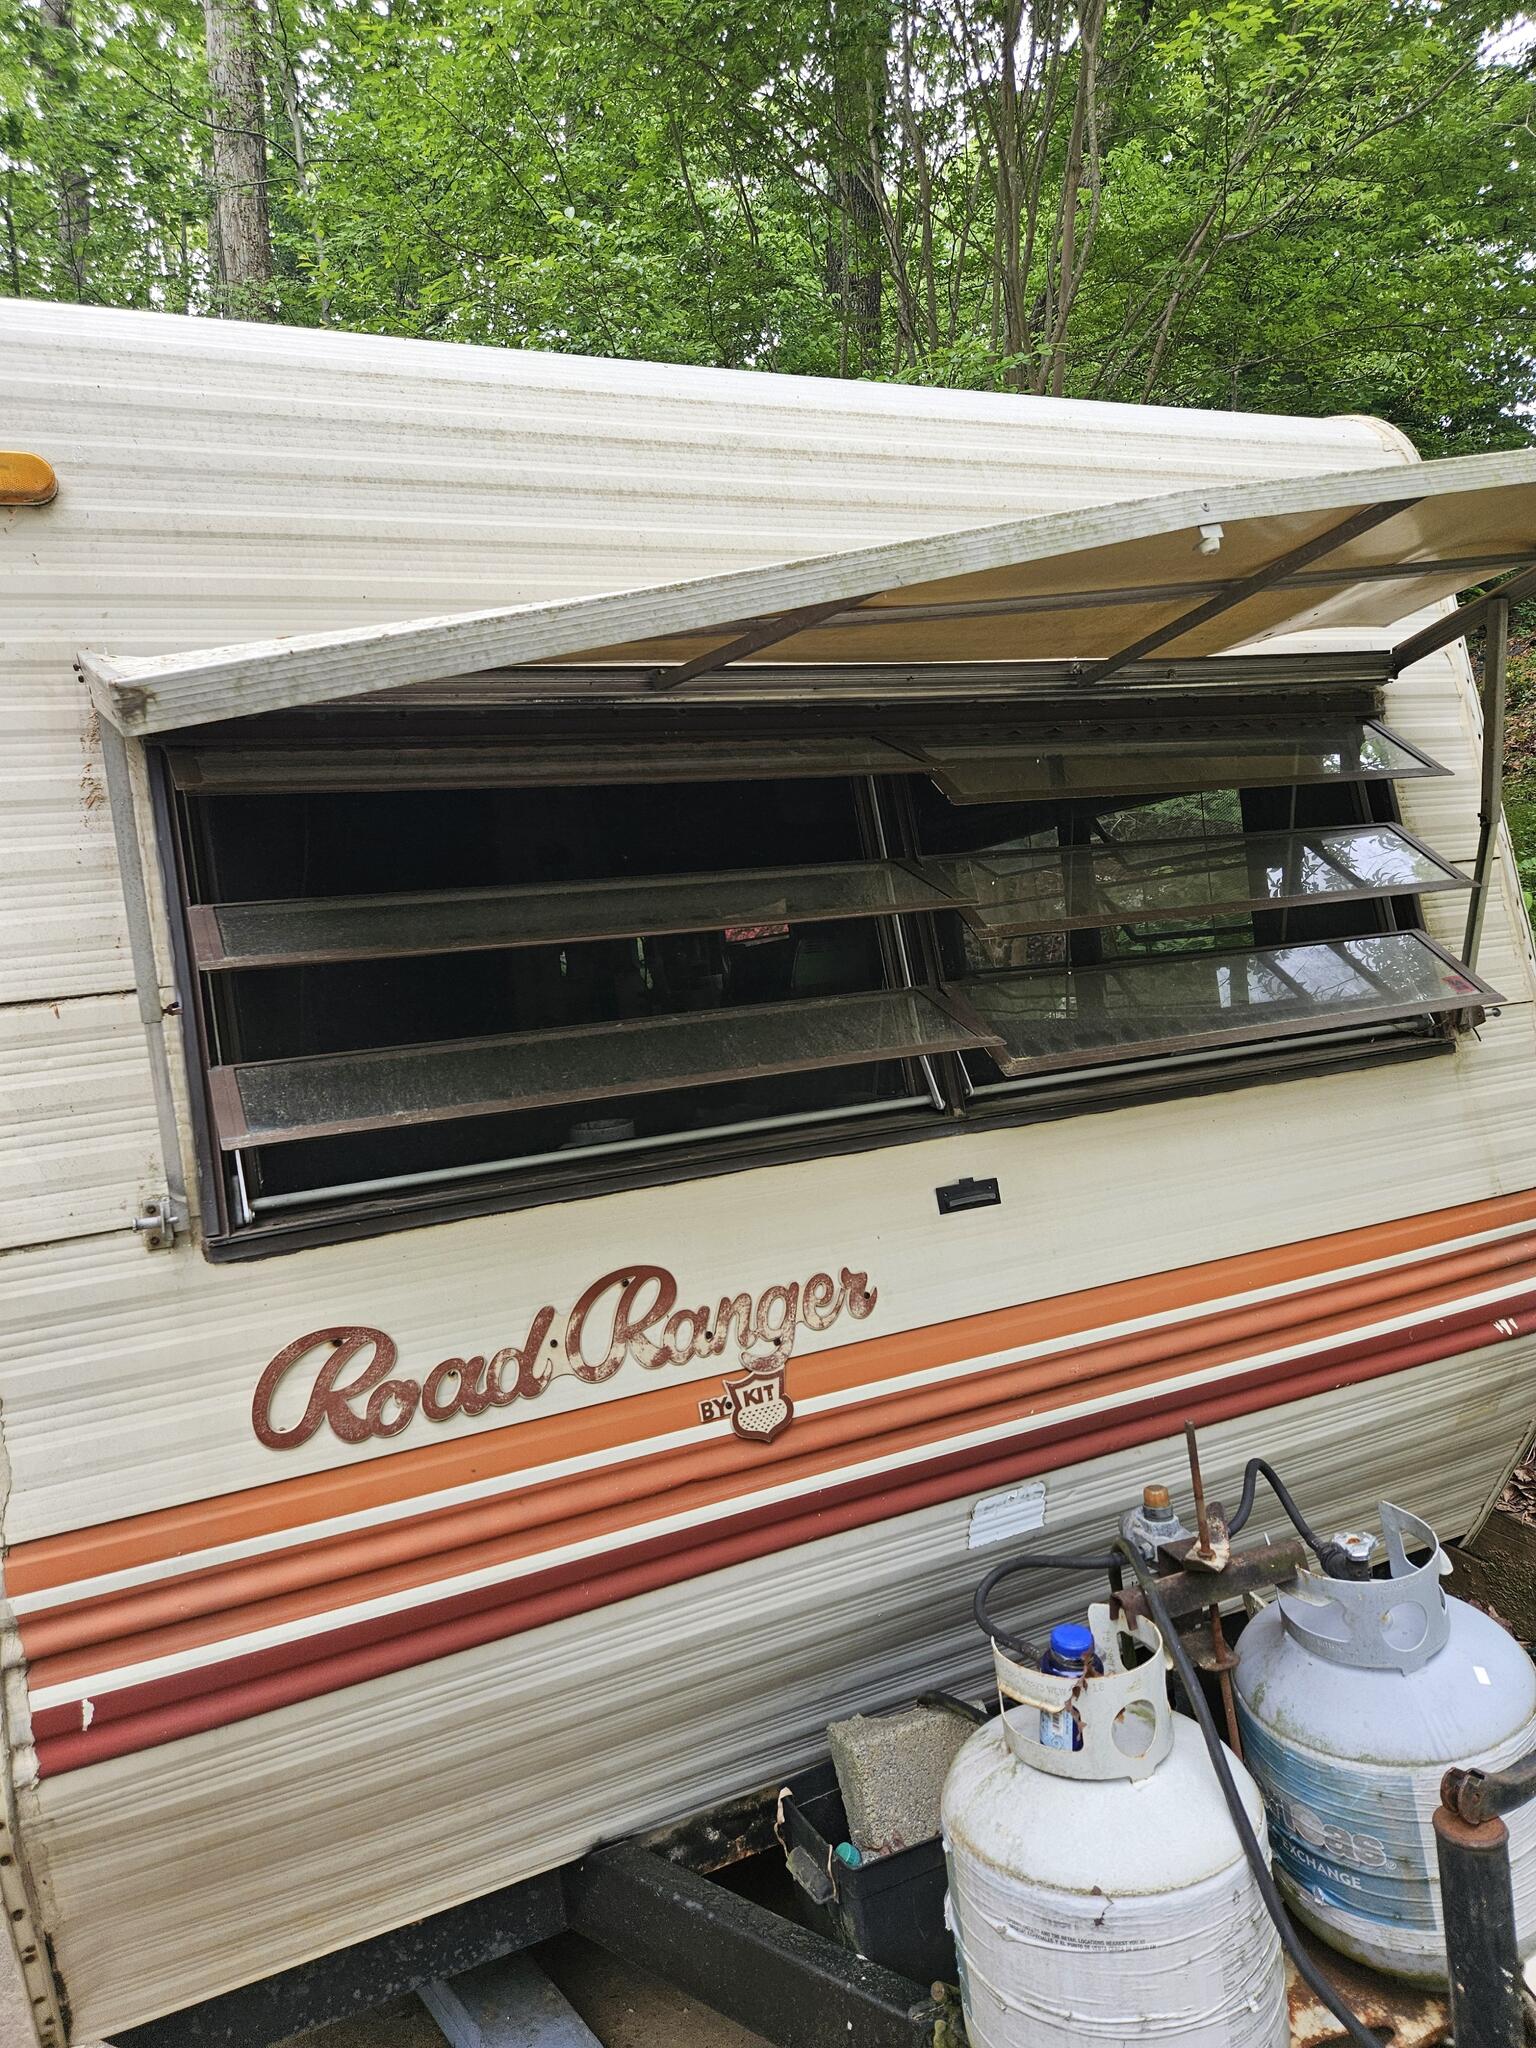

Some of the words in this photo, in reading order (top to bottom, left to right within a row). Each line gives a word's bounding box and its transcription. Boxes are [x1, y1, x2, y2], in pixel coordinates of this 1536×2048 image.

[252, 1304, 555, 1452] Road
[565, 1264, 878, 1384] Ranger
[700, 1396, 728, 1420] BY
[742, 1383, 775, 1408] KIT
[1282, 1839, 1363, 1891] EXCHANGE
